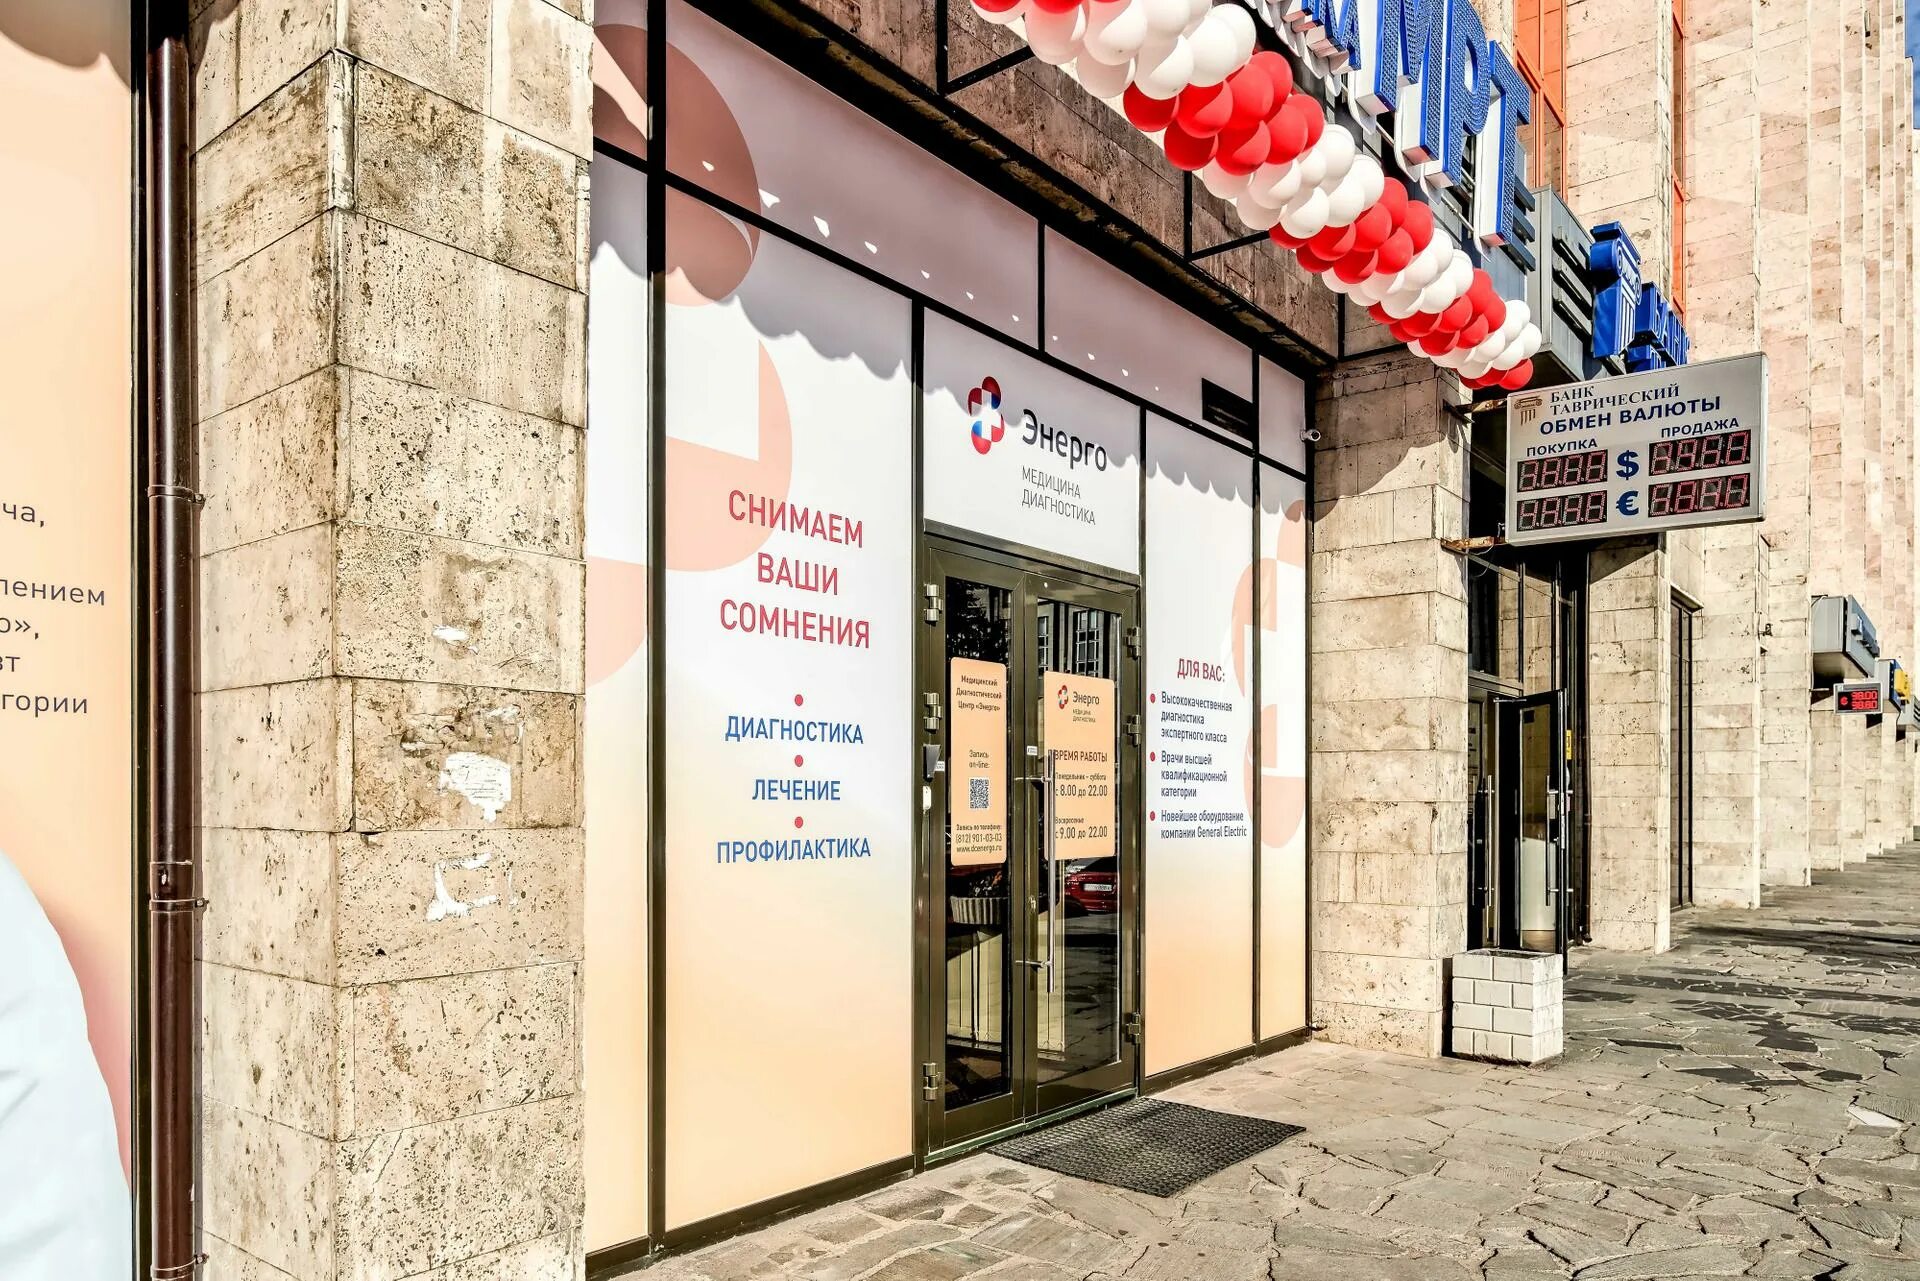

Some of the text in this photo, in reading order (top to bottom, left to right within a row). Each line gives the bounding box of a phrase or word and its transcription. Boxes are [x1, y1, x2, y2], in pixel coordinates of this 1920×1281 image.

[1550, 383, 1679, 416] ТАВРИЧЕСКИЙ
[1551, 386, 1595, 403] БАНК
[1540, 396, 1721, 435] ОБМЕН ВАЛЮТЫ
[1661, 417, 1740, 438] ПРОДАЖА
[1022, 409, 1107, 471] Энерго
[1526, 438, 1598, 457] ПОКУПКА
[1616, 450, 1640, 480] $
[1022, 466, 1081, 499] МЕДИЦИНА
[1022, 489, 1096, 525] ДИАГНОСТИКА
[1616, 490, 1639, 516] €
[729, 490, 862, 548] СНИМАЕМ
[758, 552, 838, 595] ВАШИ
[720, 599, 869, 648] СОМНЕНИЯ
[1177, 658, 1225, 682] ДЛЯ ВАС:
[961, 675, 998, 686] Медицинский
[956, 687, 1002, 699] Диагностический
[1073, 691, 1100, 706] Энерго
[1161, 691, 1232, 711] Высококачественная
[958, 700, 974, 711] Центр
[1161, 711, 1204, 724] диагностика
[725, 716, 864, 744] ДИАГНОСТИКА
[1161, 728, 1227, 743] экспертного класса
[969, 749, 989, 758] Запись
[1055, 749, 1107, 762] ВРЕМЯ РАБОТЫ
[1161, 750, 1212, 765] Врачи высшей
[1161, 769, 1227, 783] квалификационной
[752, 779, 840, 800] ЛЕЧЕНИЕ
[1060, 784, 1076, 797] 8.00
[1078, 788, 1086, 798] до
[1088, 784, 1108, 797] 22.00
[1161, 787, 1197, 800] категории
[1161, 809, 1244, 824] Новейшее оборудование
[956, 833, 1002, 844] (812) 901-03-03
[1060, 826, 1076, 839] 9.00
[1077, 830, 1086, 839] до
[1088, 825, 1108, 838] 22.00
[1161, 825, 1247, 839] компании General Electric
[717, 837, 871, 863] ПРОФИЛАКТИКА
